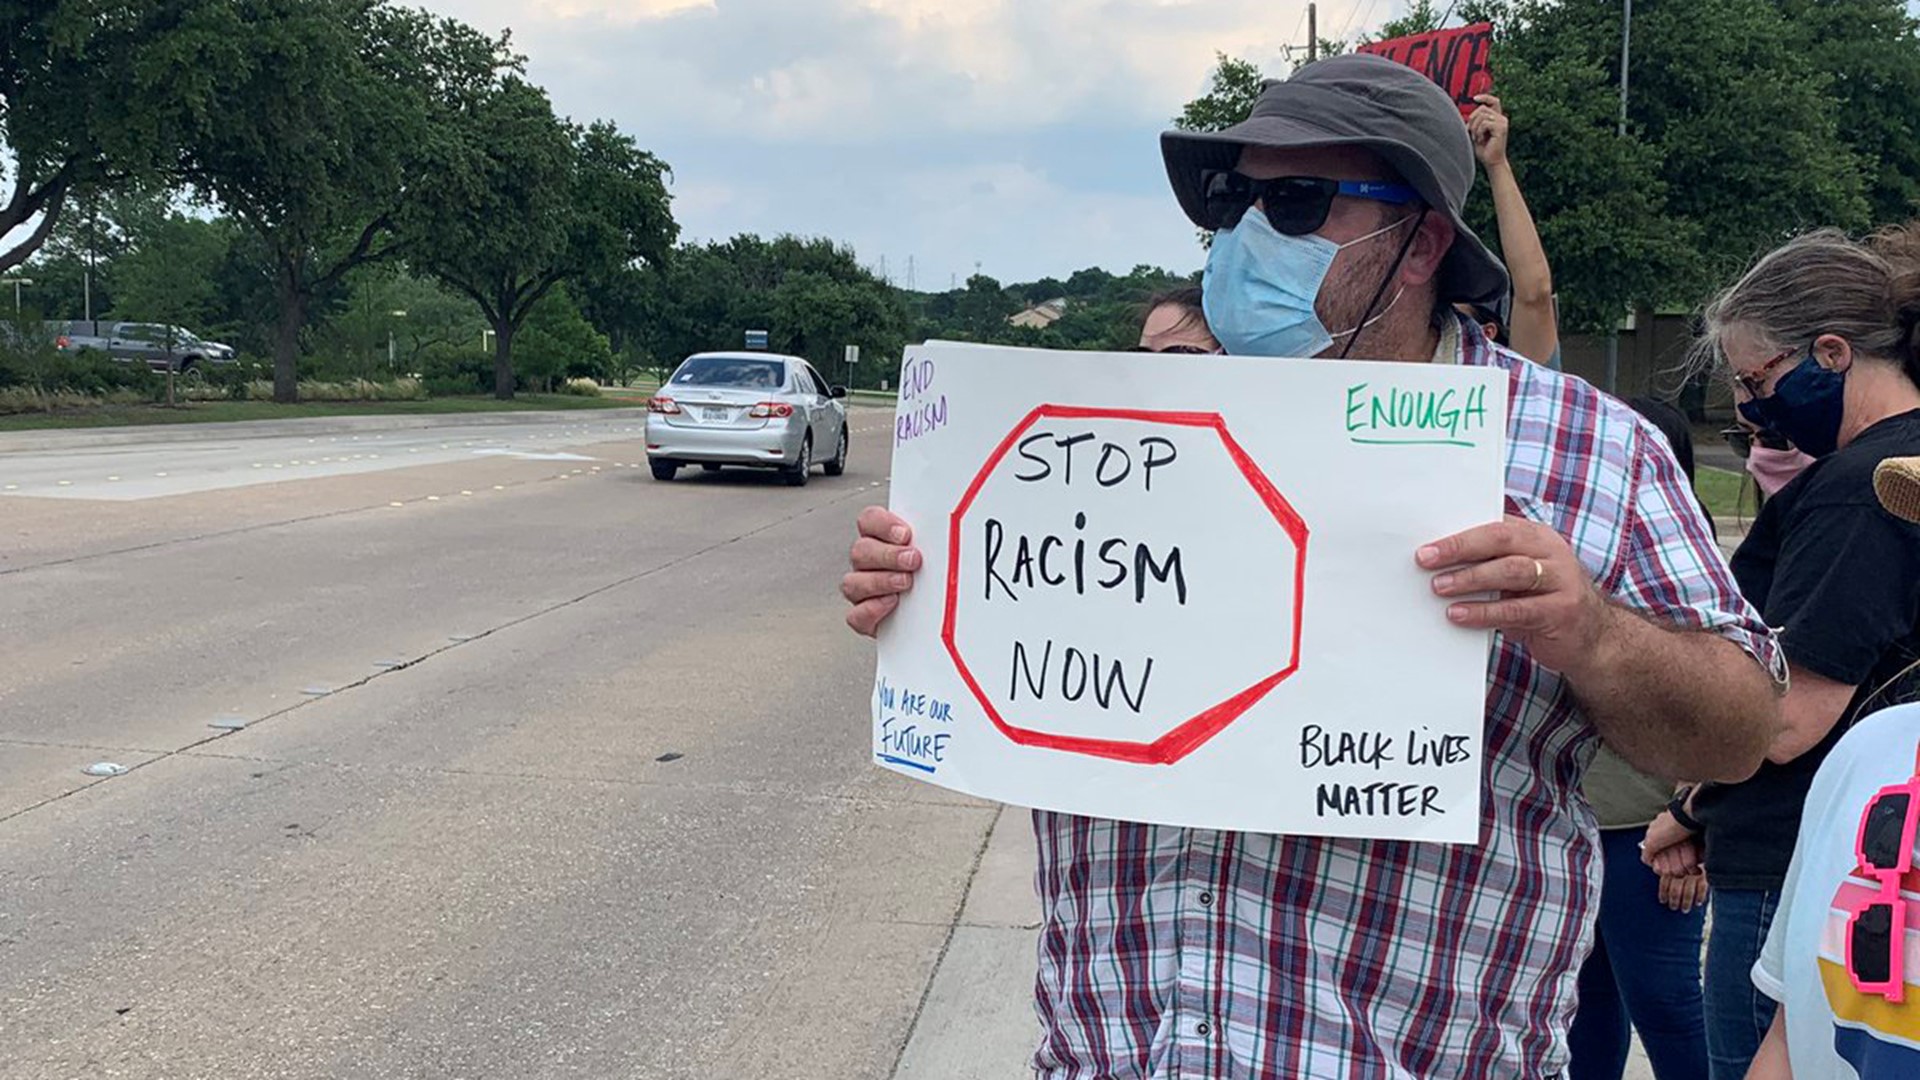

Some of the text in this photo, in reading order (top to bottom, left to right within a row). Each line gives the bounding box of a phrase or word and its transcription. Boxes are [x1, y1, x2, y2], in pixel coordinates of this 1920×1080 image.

[903, 357, 934, 401] END
[1346, 383, 1488, 438] ENOUGH
[1015, 432, 1177, 491] STOP
[877, 676, 953, 722] YOU ARE OUR
[1010, 640, 1153, 712] NOW
[881, 716, 951, 762] FUTURE
[1300, 724, 1394, 770] BLACK
[1316, 782, 1445, 816] MATTER
